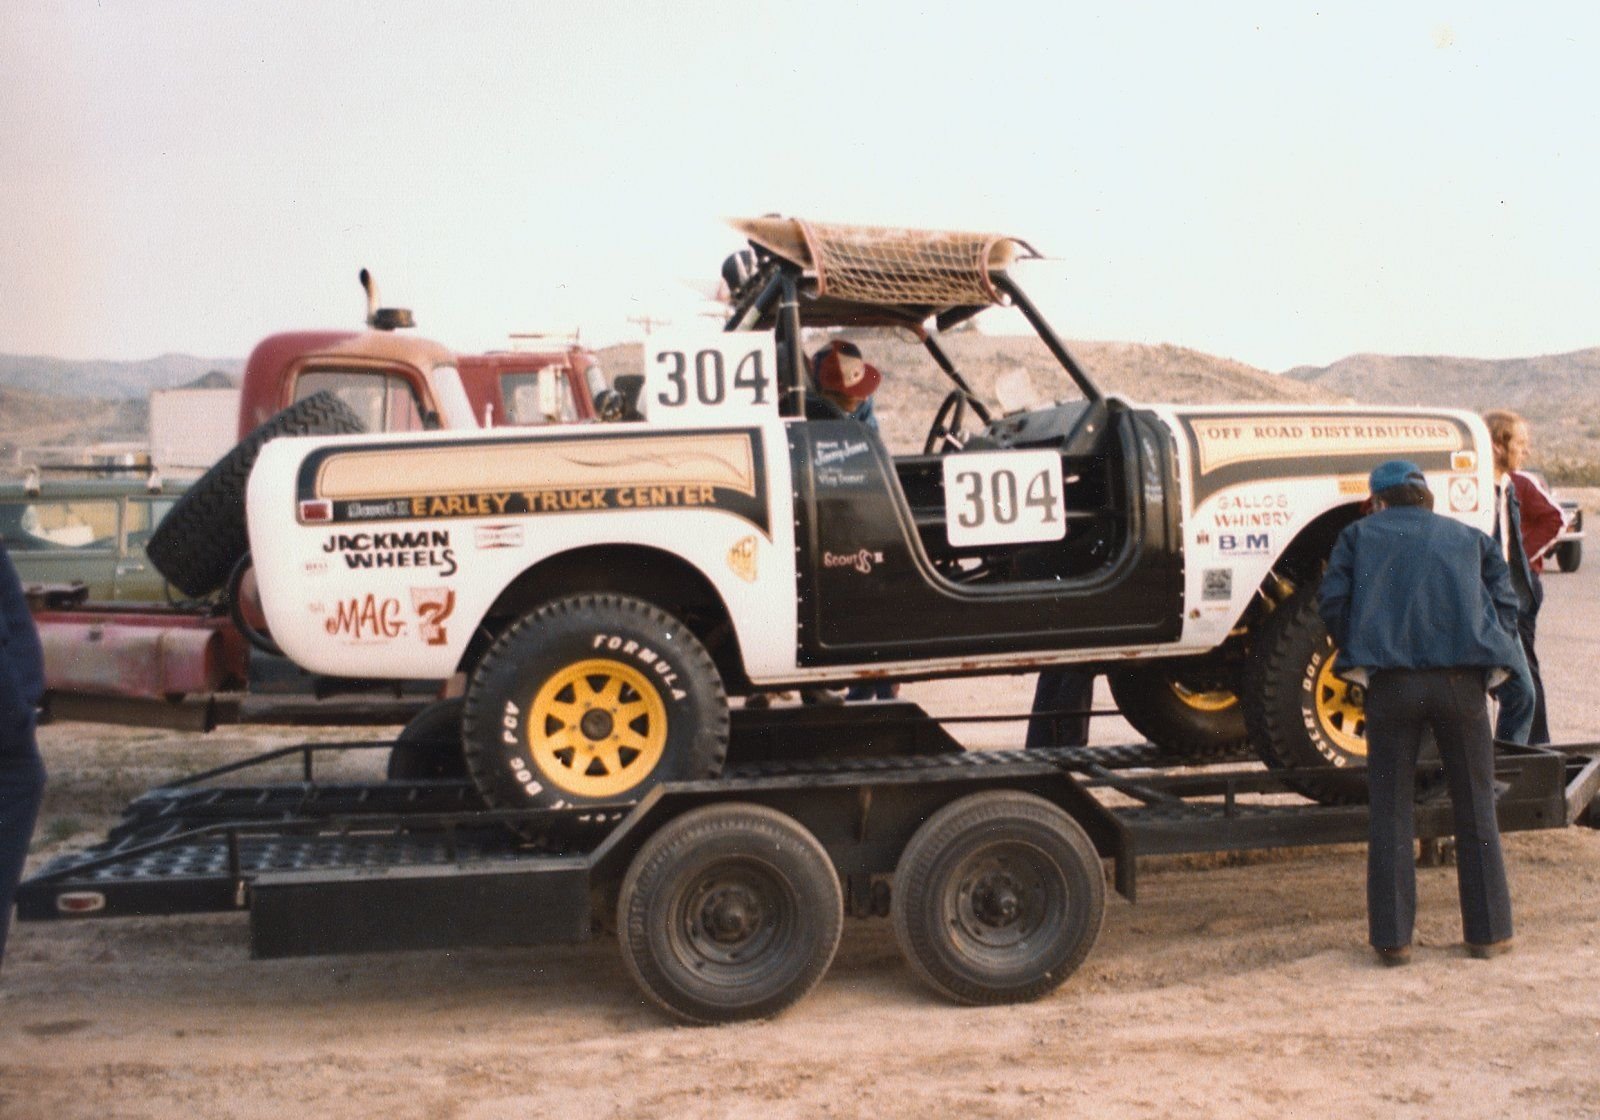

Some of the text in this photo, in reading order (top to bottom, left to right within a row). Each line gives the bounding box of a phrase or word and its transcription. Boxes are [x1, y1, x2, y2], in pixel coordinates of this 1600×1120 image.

[656, 349, 770, 407] 304
[1206, 425, 1450, 440] OFF ROAD DISTRIBUTORS
[411, 494, 509, 516] EARLEY
[524, 490, 605, 512] TRUCK
[616, 484, 716, 508] CENTER
[955, 469, 1058, 529] 304
[324, 531, 449, 552] JACKMAN
[345, 550, 457, 576] WHEELS
[593, 633, 688, 701] FORMULA
[1301, 705, 1347, 768] DESERT
